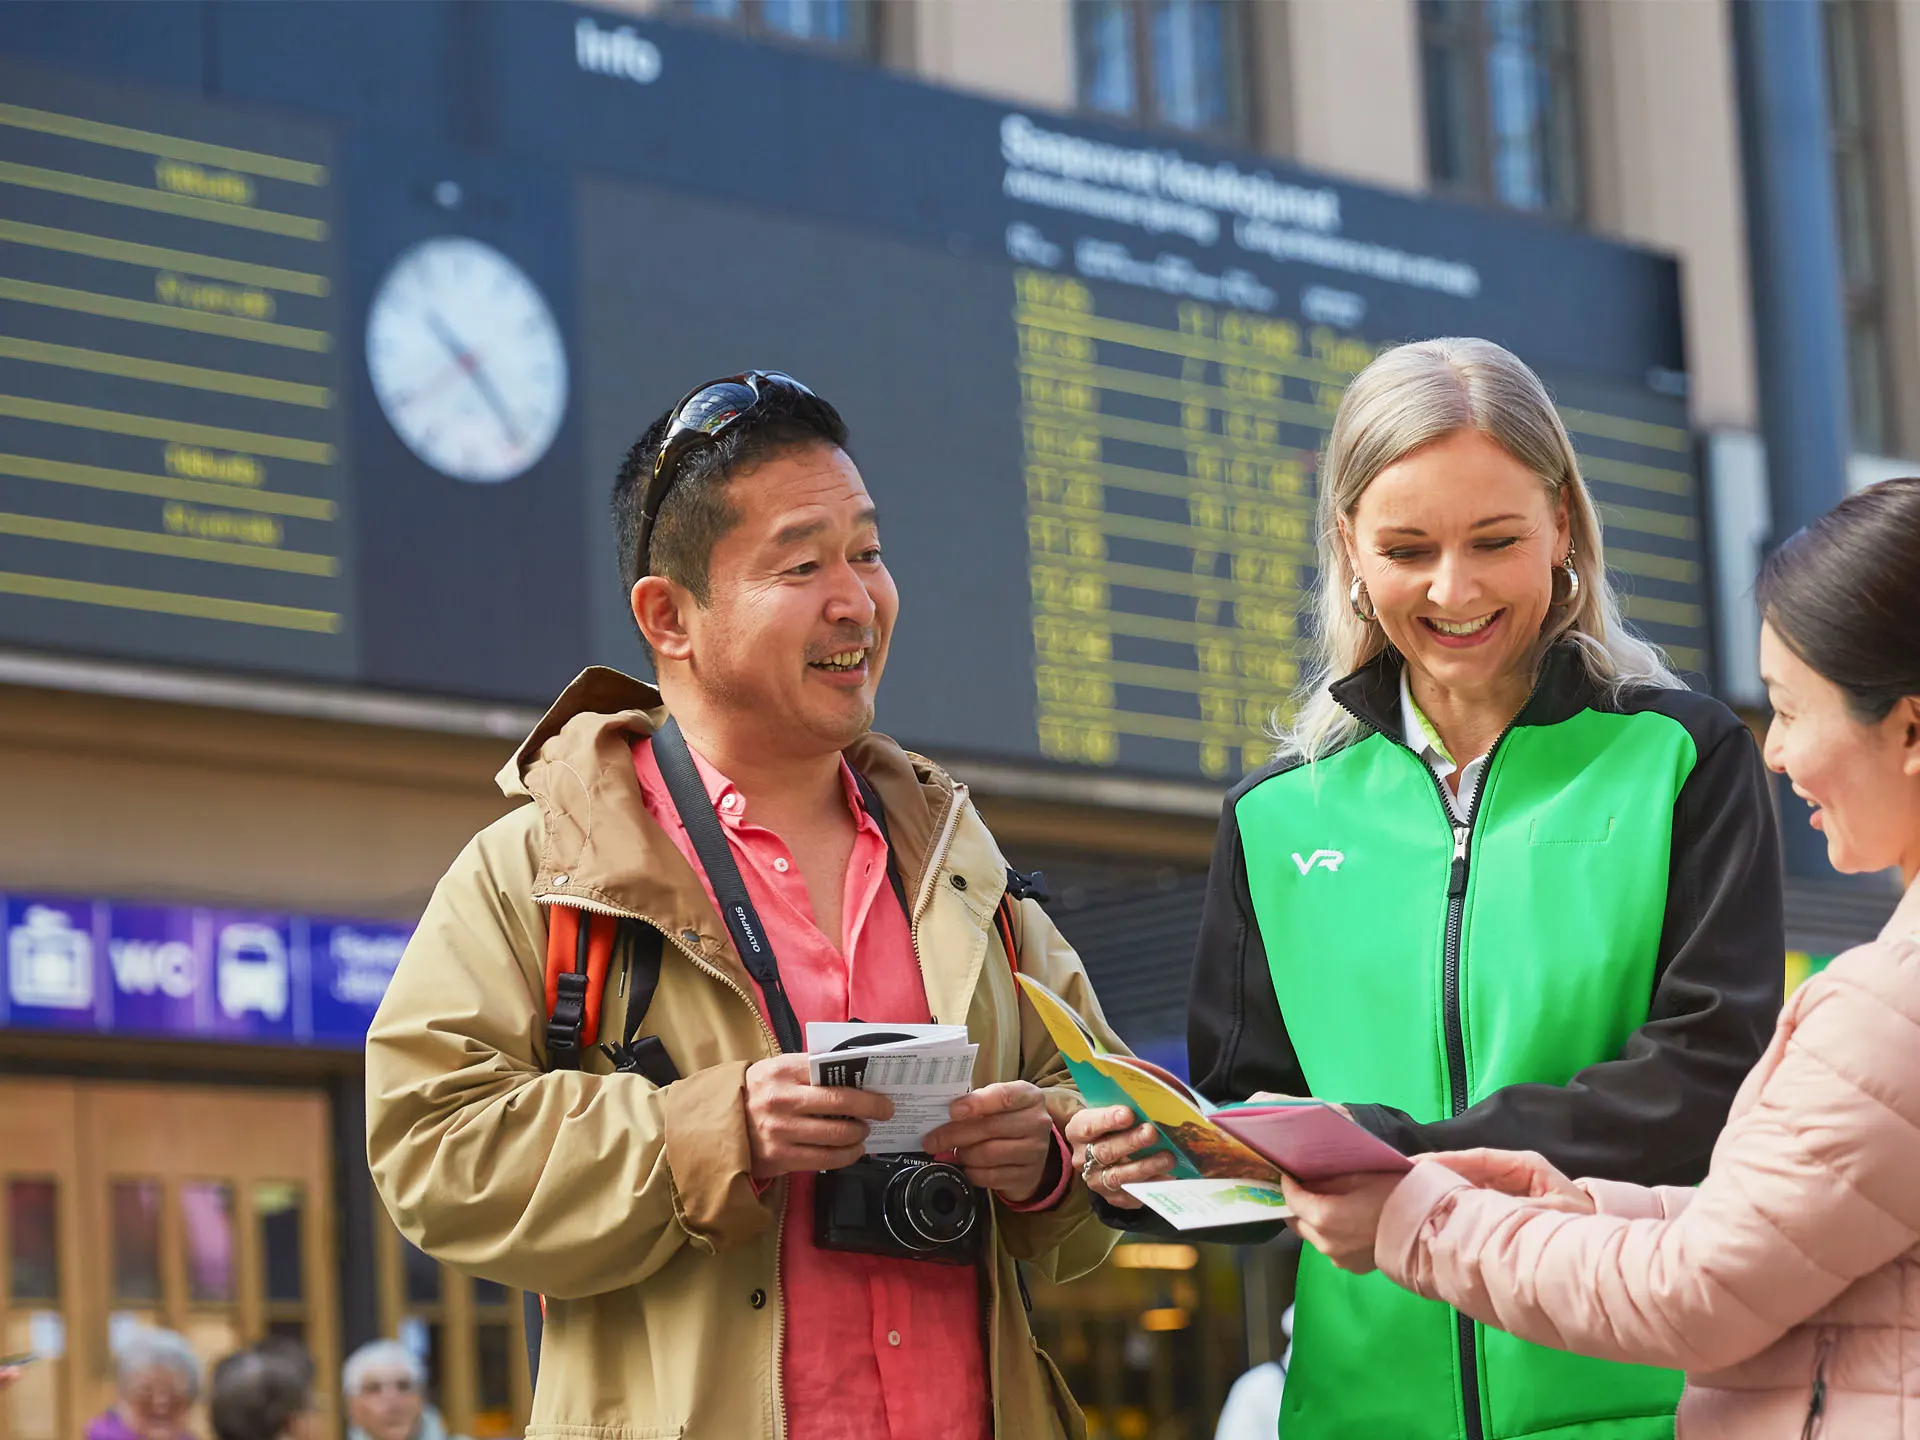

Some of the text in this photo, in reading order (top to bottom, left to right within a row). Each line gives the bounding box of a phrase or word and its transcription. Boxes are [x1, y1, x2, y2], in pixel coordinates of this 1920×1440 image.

[576, 18, 662, 83] Info
[1291, 849, 1345, 876] VR
[735, 906, 761, 953] OLYMPUS
[111, 938, 197, 997] WC
